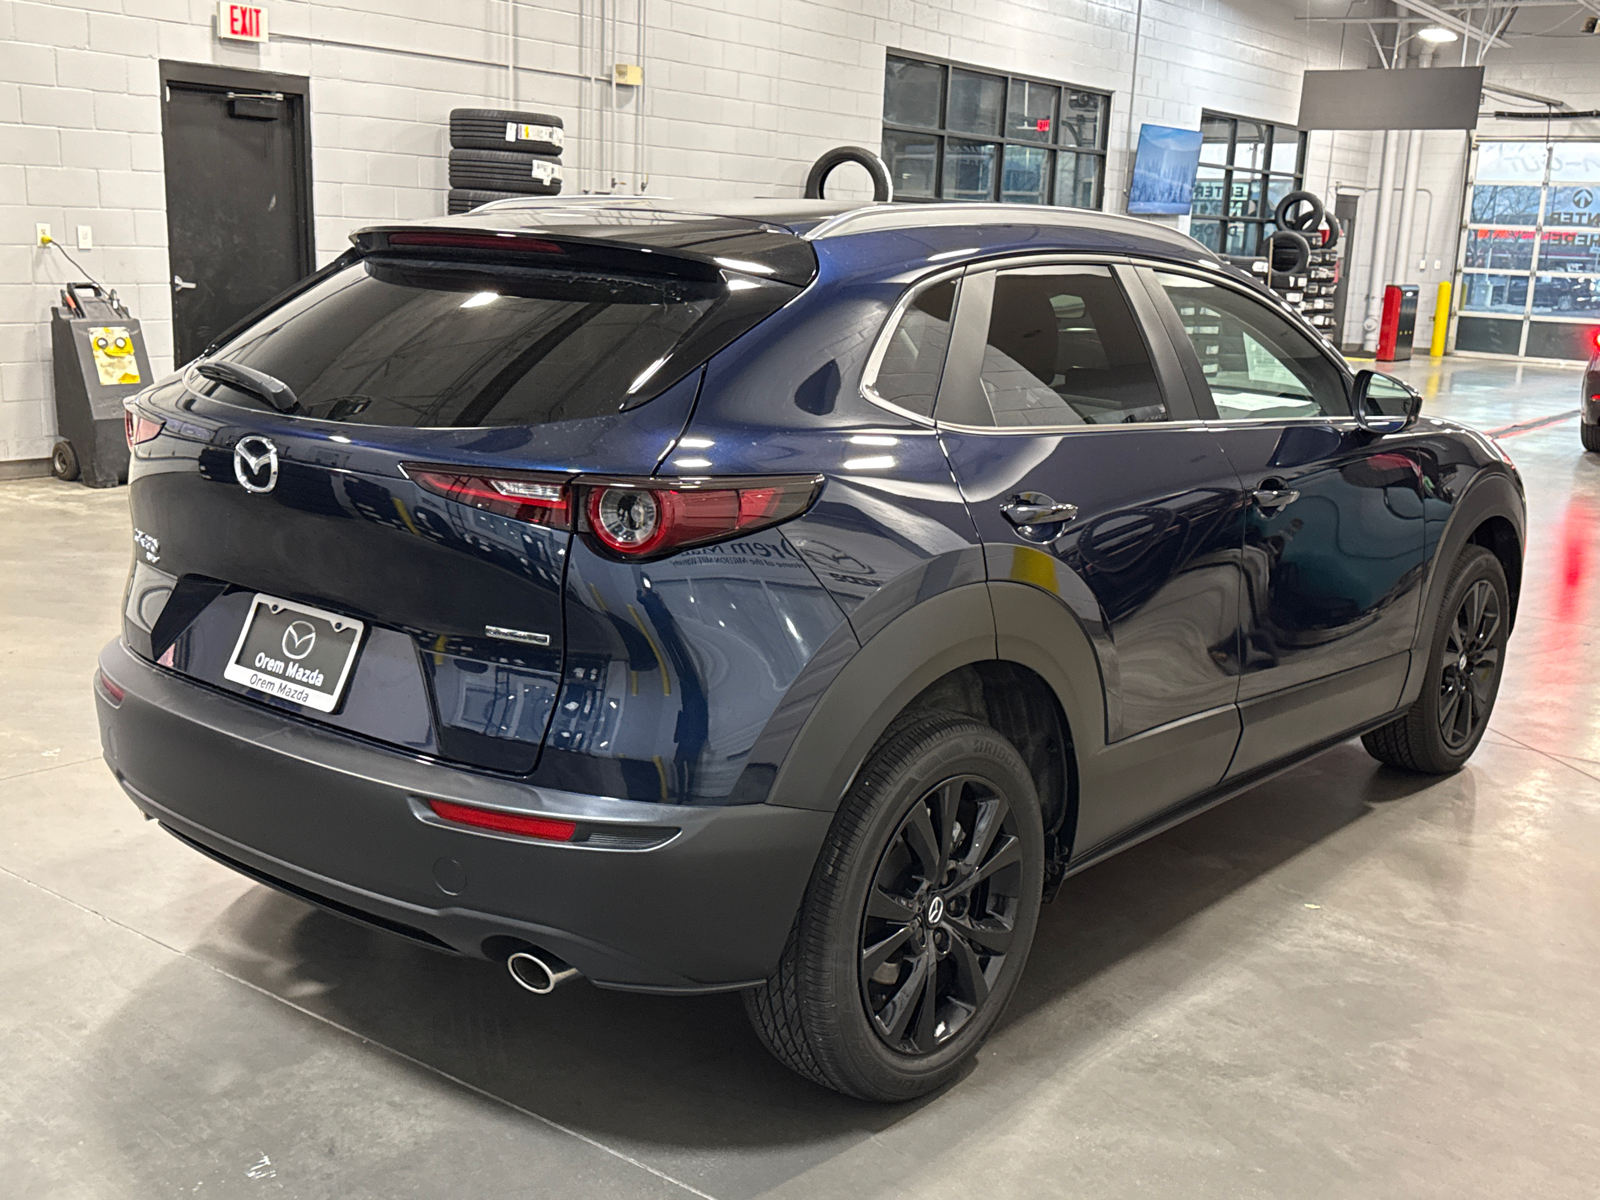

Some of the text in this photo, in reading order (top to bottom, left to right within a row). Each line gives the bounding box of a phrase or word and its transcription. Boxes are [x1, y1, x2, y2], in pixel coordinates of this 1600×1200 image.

[230, 4, 262, 38] EXIT
[254, 651, 325, 687] Orem Mazda
[249, 673, 310, 703] Orem Mazda
